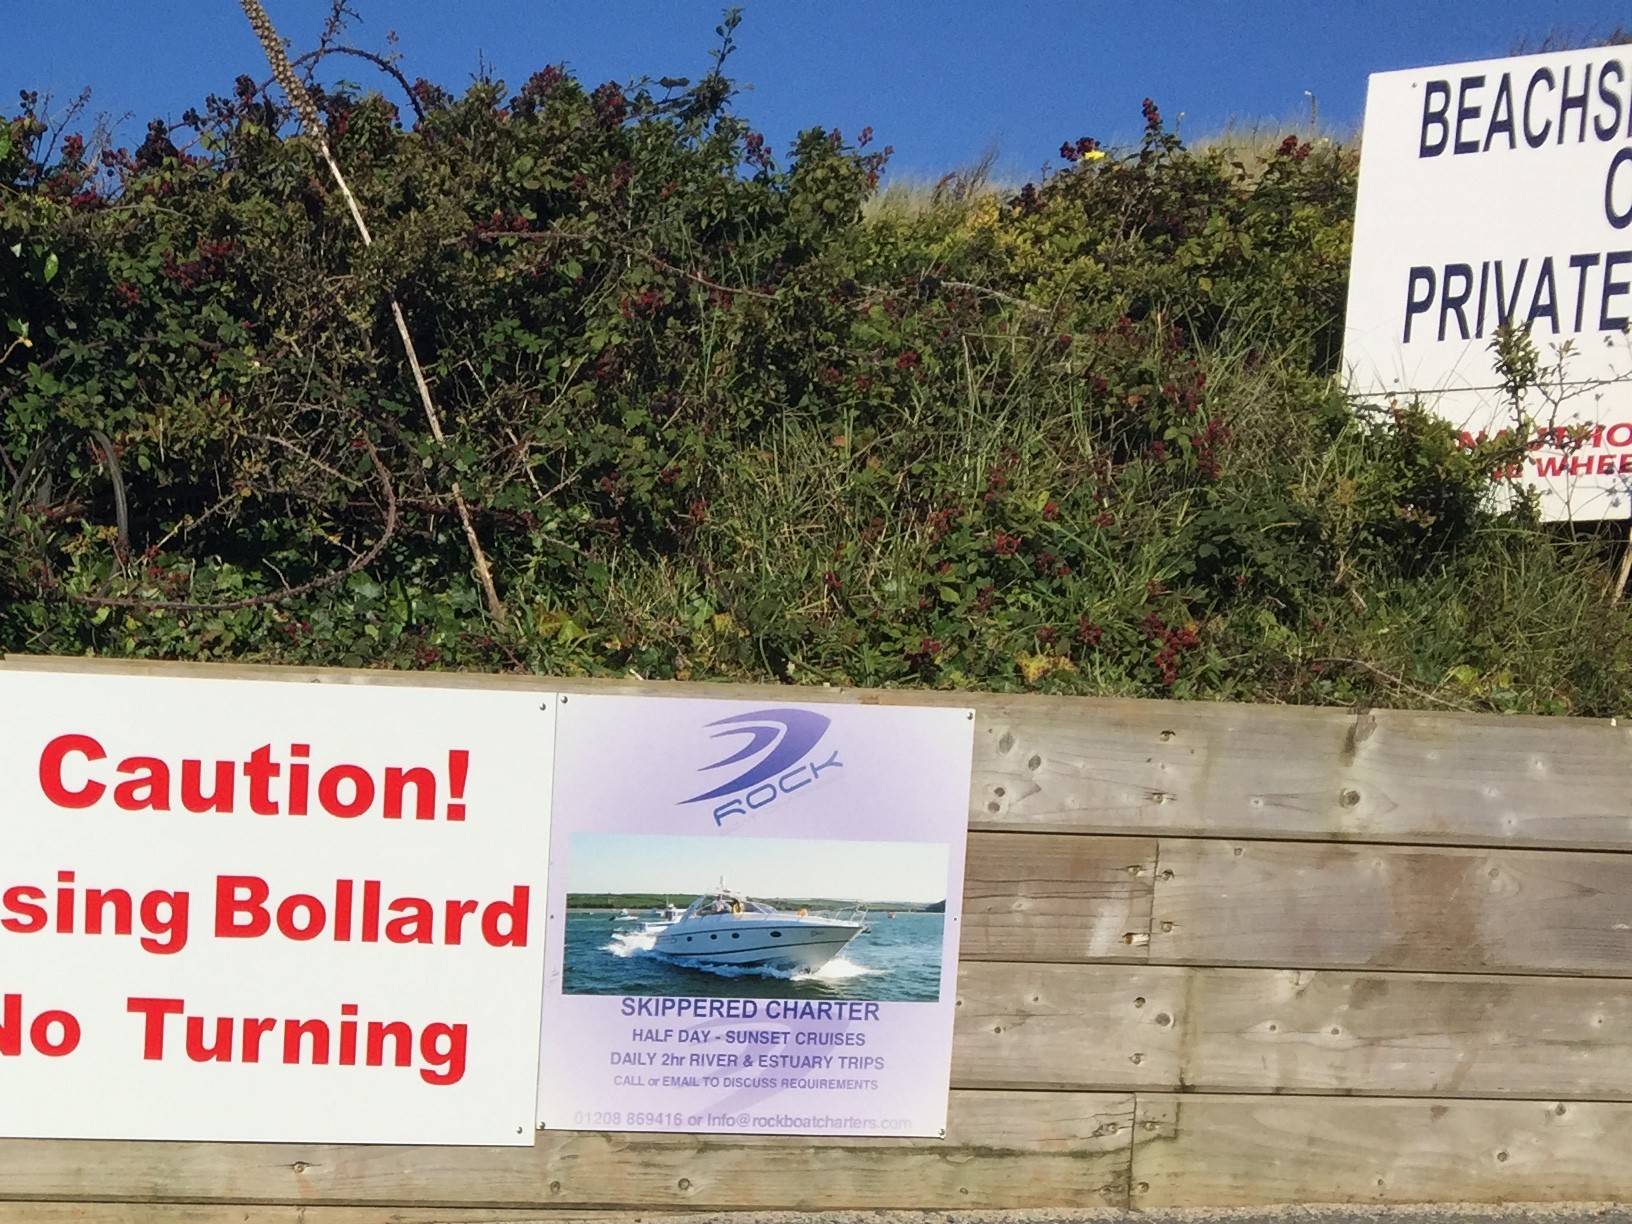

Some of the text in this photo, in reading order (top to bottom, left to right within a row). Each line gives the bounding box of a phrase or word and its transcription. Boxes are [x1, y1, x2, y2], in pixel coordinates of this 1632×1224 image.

[1419, 58, 1632, 159] BEACHS
[1403, 249, 1632, 344] PRIVATE
[38, 733, 470, 822] Caution!
[713, 749, 844, 827] ROCK
[214, 874, 530, 948] Bollard
[126, 996, 468, 1086] Turning
[620, 996, 880, 1021] SKIPPERED CHARTER
[631, 1028, 674, 1043] HALF
[677, 1029, 711, 1044] DAY
[724, 1029, 791, 1045] SUNSET
[794, 1031, 866, 1047] CRUISES
[609, 1051, 885, 1071] DAILY 2hr RIVER & ESTUARY TRIPS
[613, 1074, 879, 1091] CALL or EMAIL TO DISCUSS REQUIREMENTS
[573, 1110, 622, 1126] 01208
[626, 1111, 684, 1127] 869416
[687, 1115, 704, 1127] or
